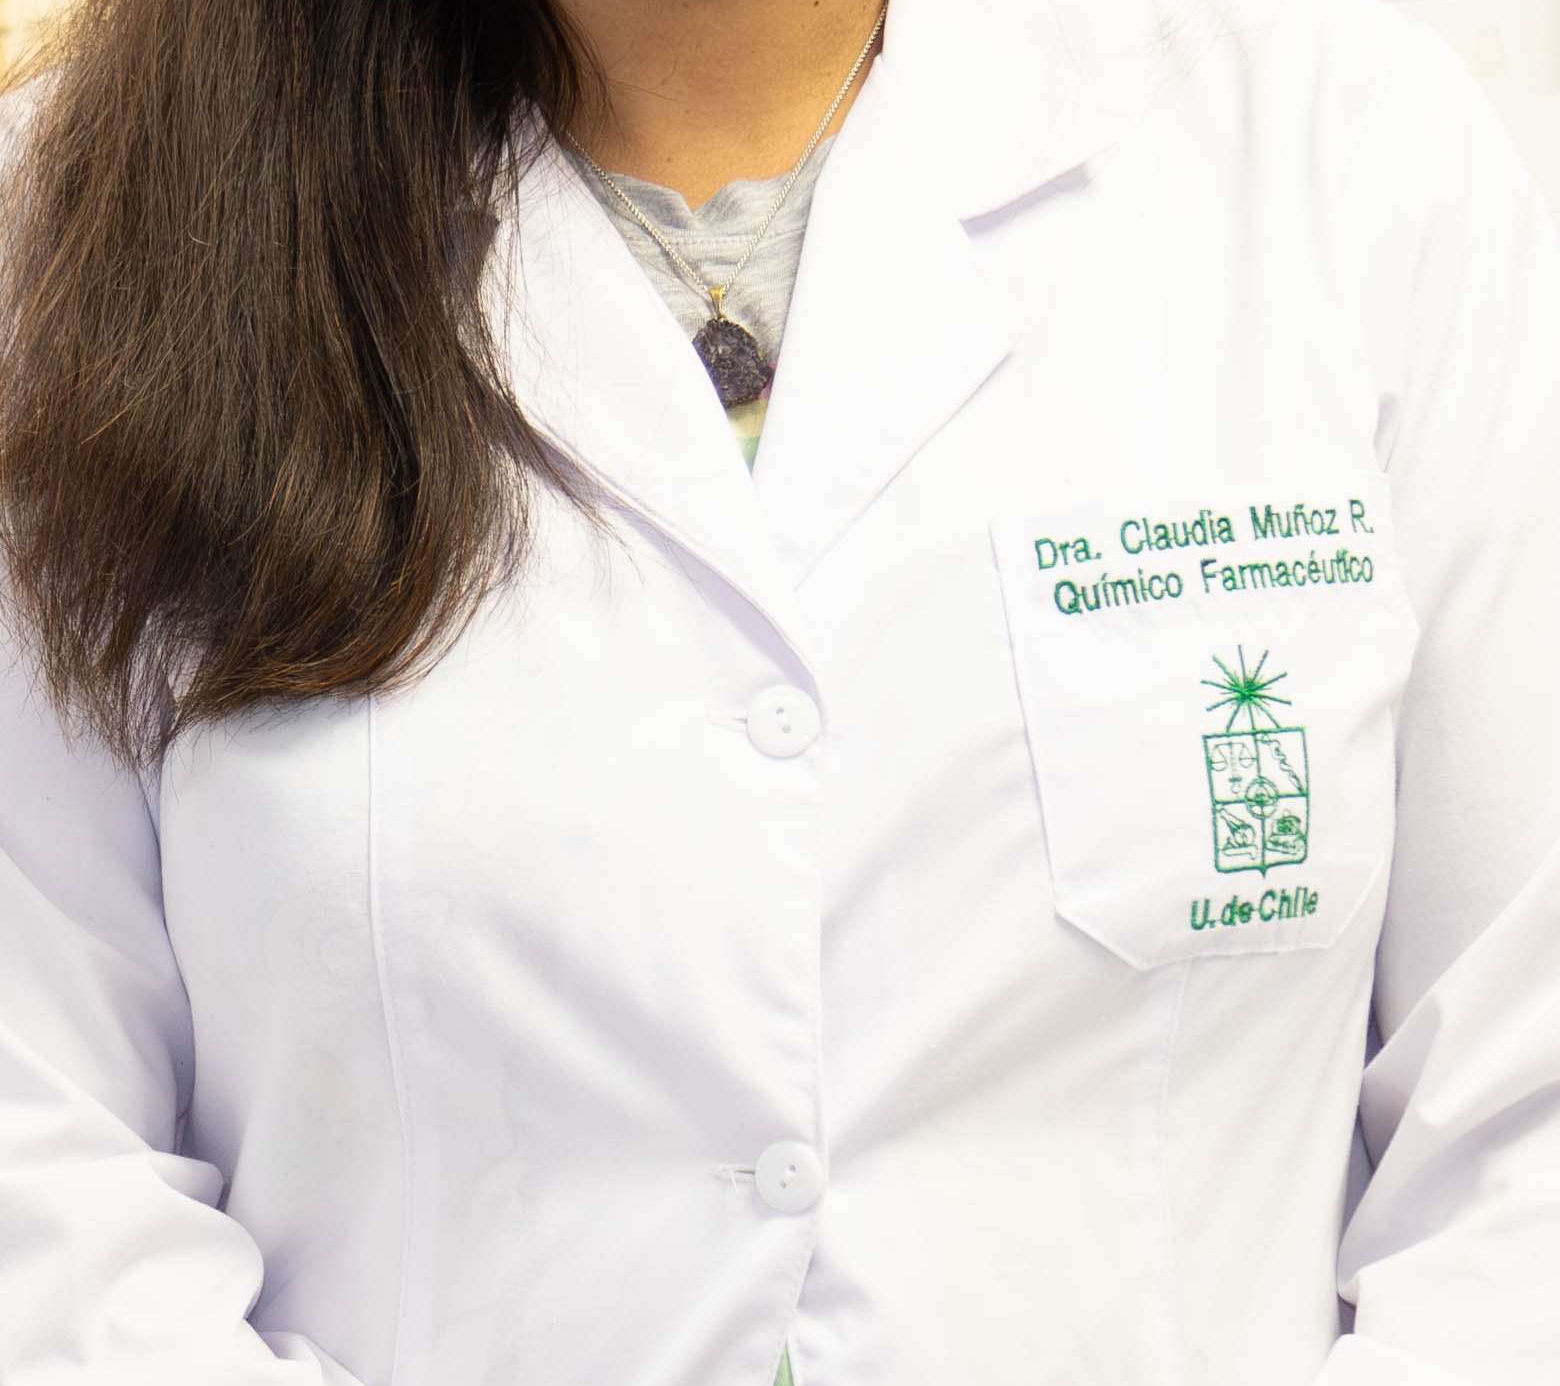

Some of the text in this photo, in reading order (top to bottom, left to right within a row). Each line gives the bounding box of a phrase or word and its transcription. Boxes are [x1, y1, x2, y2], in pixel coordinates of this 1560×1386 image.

[1034, 498, 1375, 570] Dra. Claudia Muñoz R.
[1053, 549, 1374, 615] Químico Farmacéutico
[1190, 898, 1216, 931] U.
[1259, 885, 1319, 923] Chile
